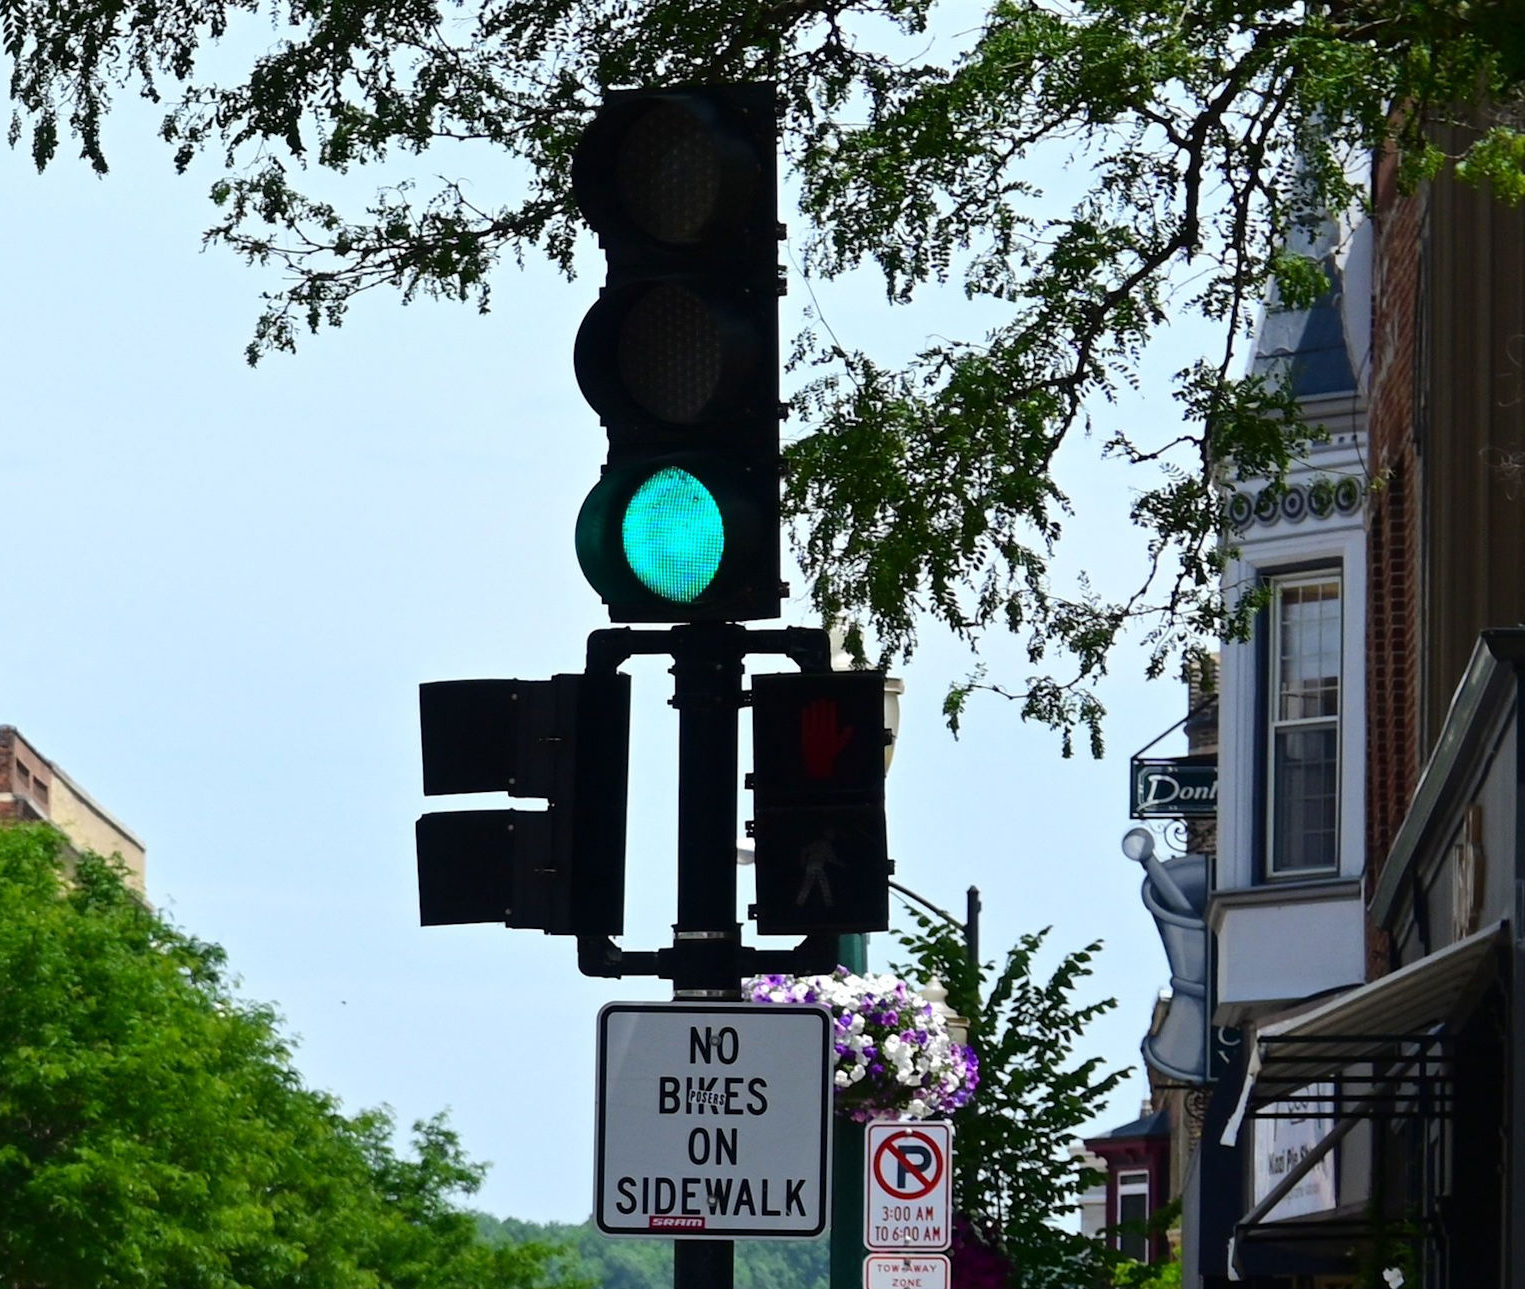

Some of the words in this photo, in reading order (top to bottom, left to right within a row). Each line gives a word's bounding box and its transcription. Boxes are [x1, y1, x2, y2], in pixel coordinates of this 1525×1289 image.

[690, 1027, 739, 1065] NO
[659, 1077, 768, 1115] BIKES
[690, 1090, 725, 1106] POSERS
[688, 1128, 738, 1165] ON
[616, 1177, 807, 1216] SIDEWALK
[882, 1206, 910, 1221] 3:00
[916, 1206, 934, 1221] AM
[652, 1217, 702, 1228] SRAM
[875, 1226, 888, 1241] TO
[892, 1226, 919, 1241] 6:00
[923, 1226, 941, 1241] AM
[892, 1279, 922, 1287] ZONE
